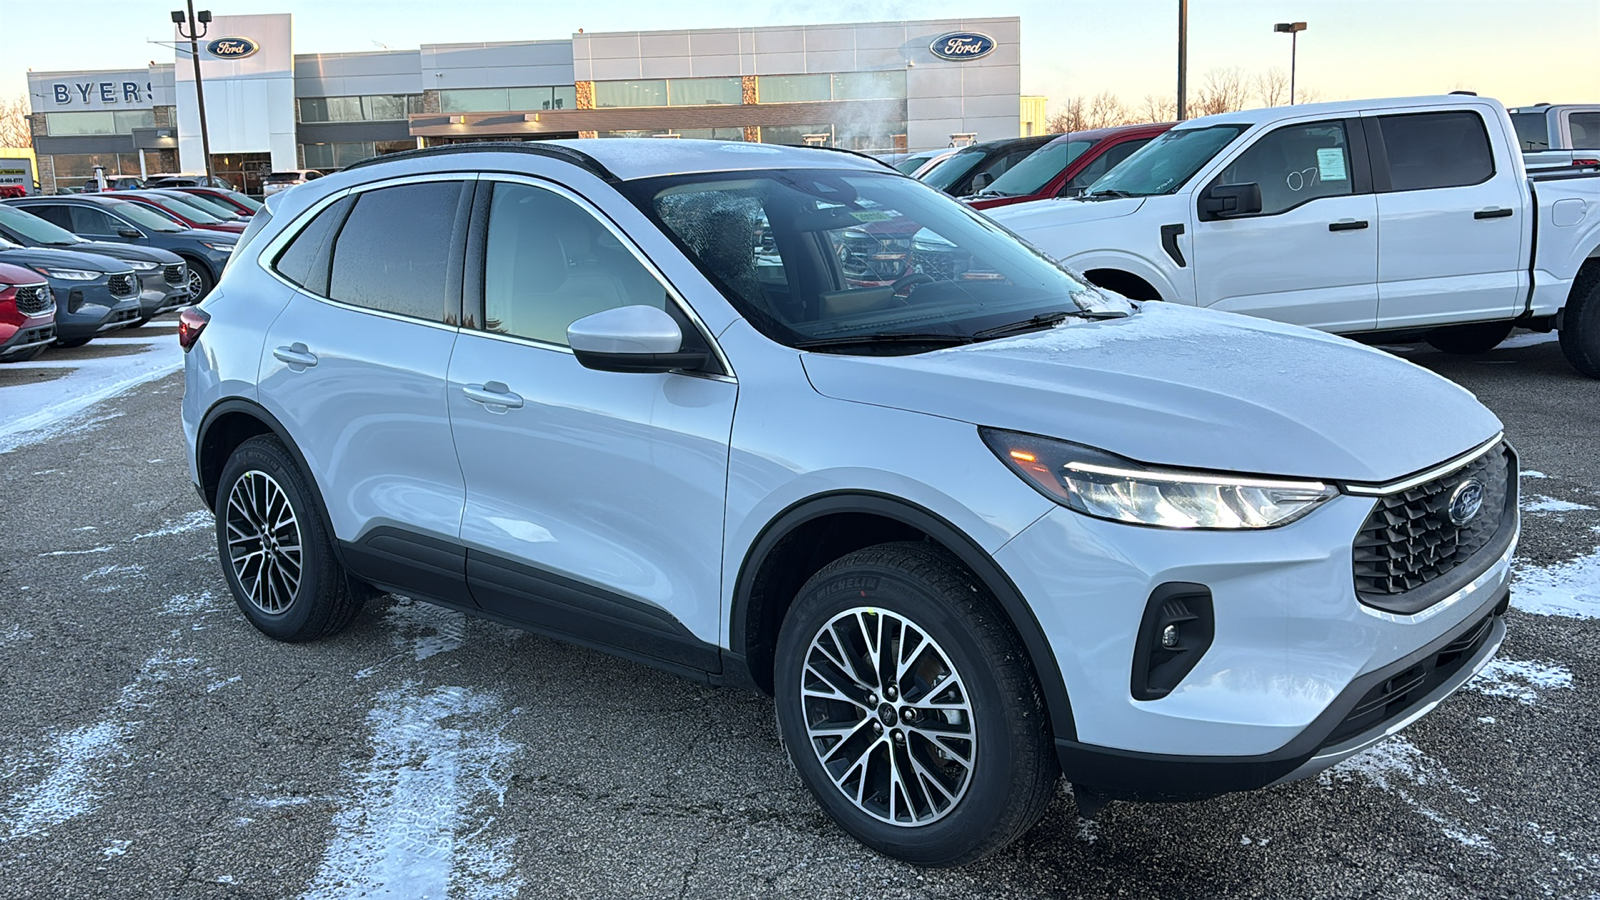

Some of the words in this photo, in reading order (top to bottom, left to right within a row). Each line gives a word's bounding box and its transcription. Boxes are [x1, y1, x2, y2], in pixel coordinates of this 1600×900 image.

[216, 41, 245, 54] Ford
[944, 38, 982, 54] Ford
[1287, 167, 1318, 191] 07
[817, 577, 877, 599] MICHELIN
